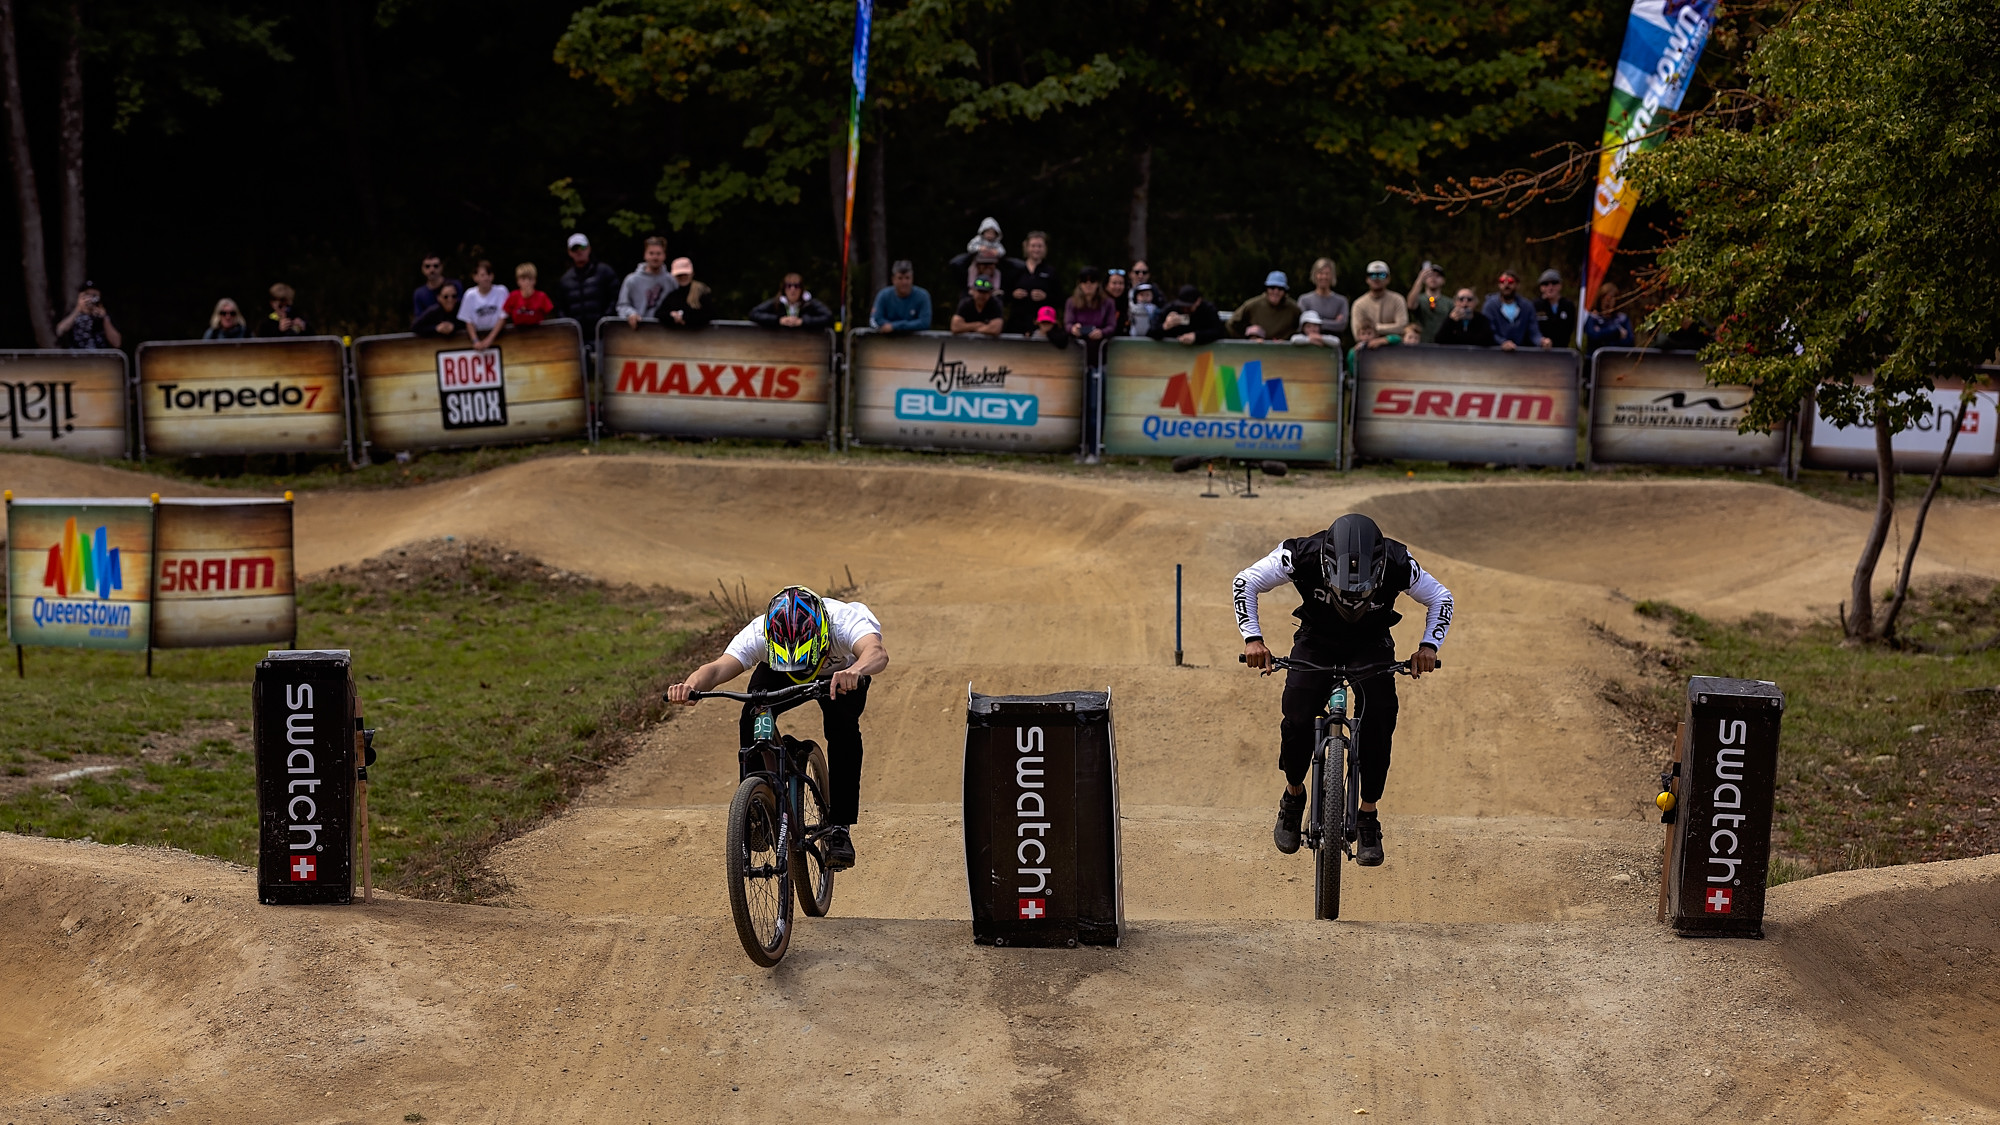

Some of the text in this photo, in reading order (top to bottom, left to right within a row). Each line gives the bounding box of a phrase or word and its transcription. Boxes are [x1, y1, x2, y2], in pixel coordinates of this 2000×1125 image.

[443, 352, 497, 386] ROCK
[616, 361, 801, 400] MAXXIS
[157, 382, 323, 413] Torpedo7
[446, 391, 501, 424] SHOX
[900, 393, 1032, 420] BUNGY
[1372, 387, 1554, 421] SRAM
[1142, 415, 1304, 441] Queenstown
[160, 556, 274, 591] SRAM
[33, 596, 130, 628] Queenstown
[286, 683, 322, 850] swatch
[1016, 726, 1052, 893] swatch
[1706, 719, 1747, 883] swatch
